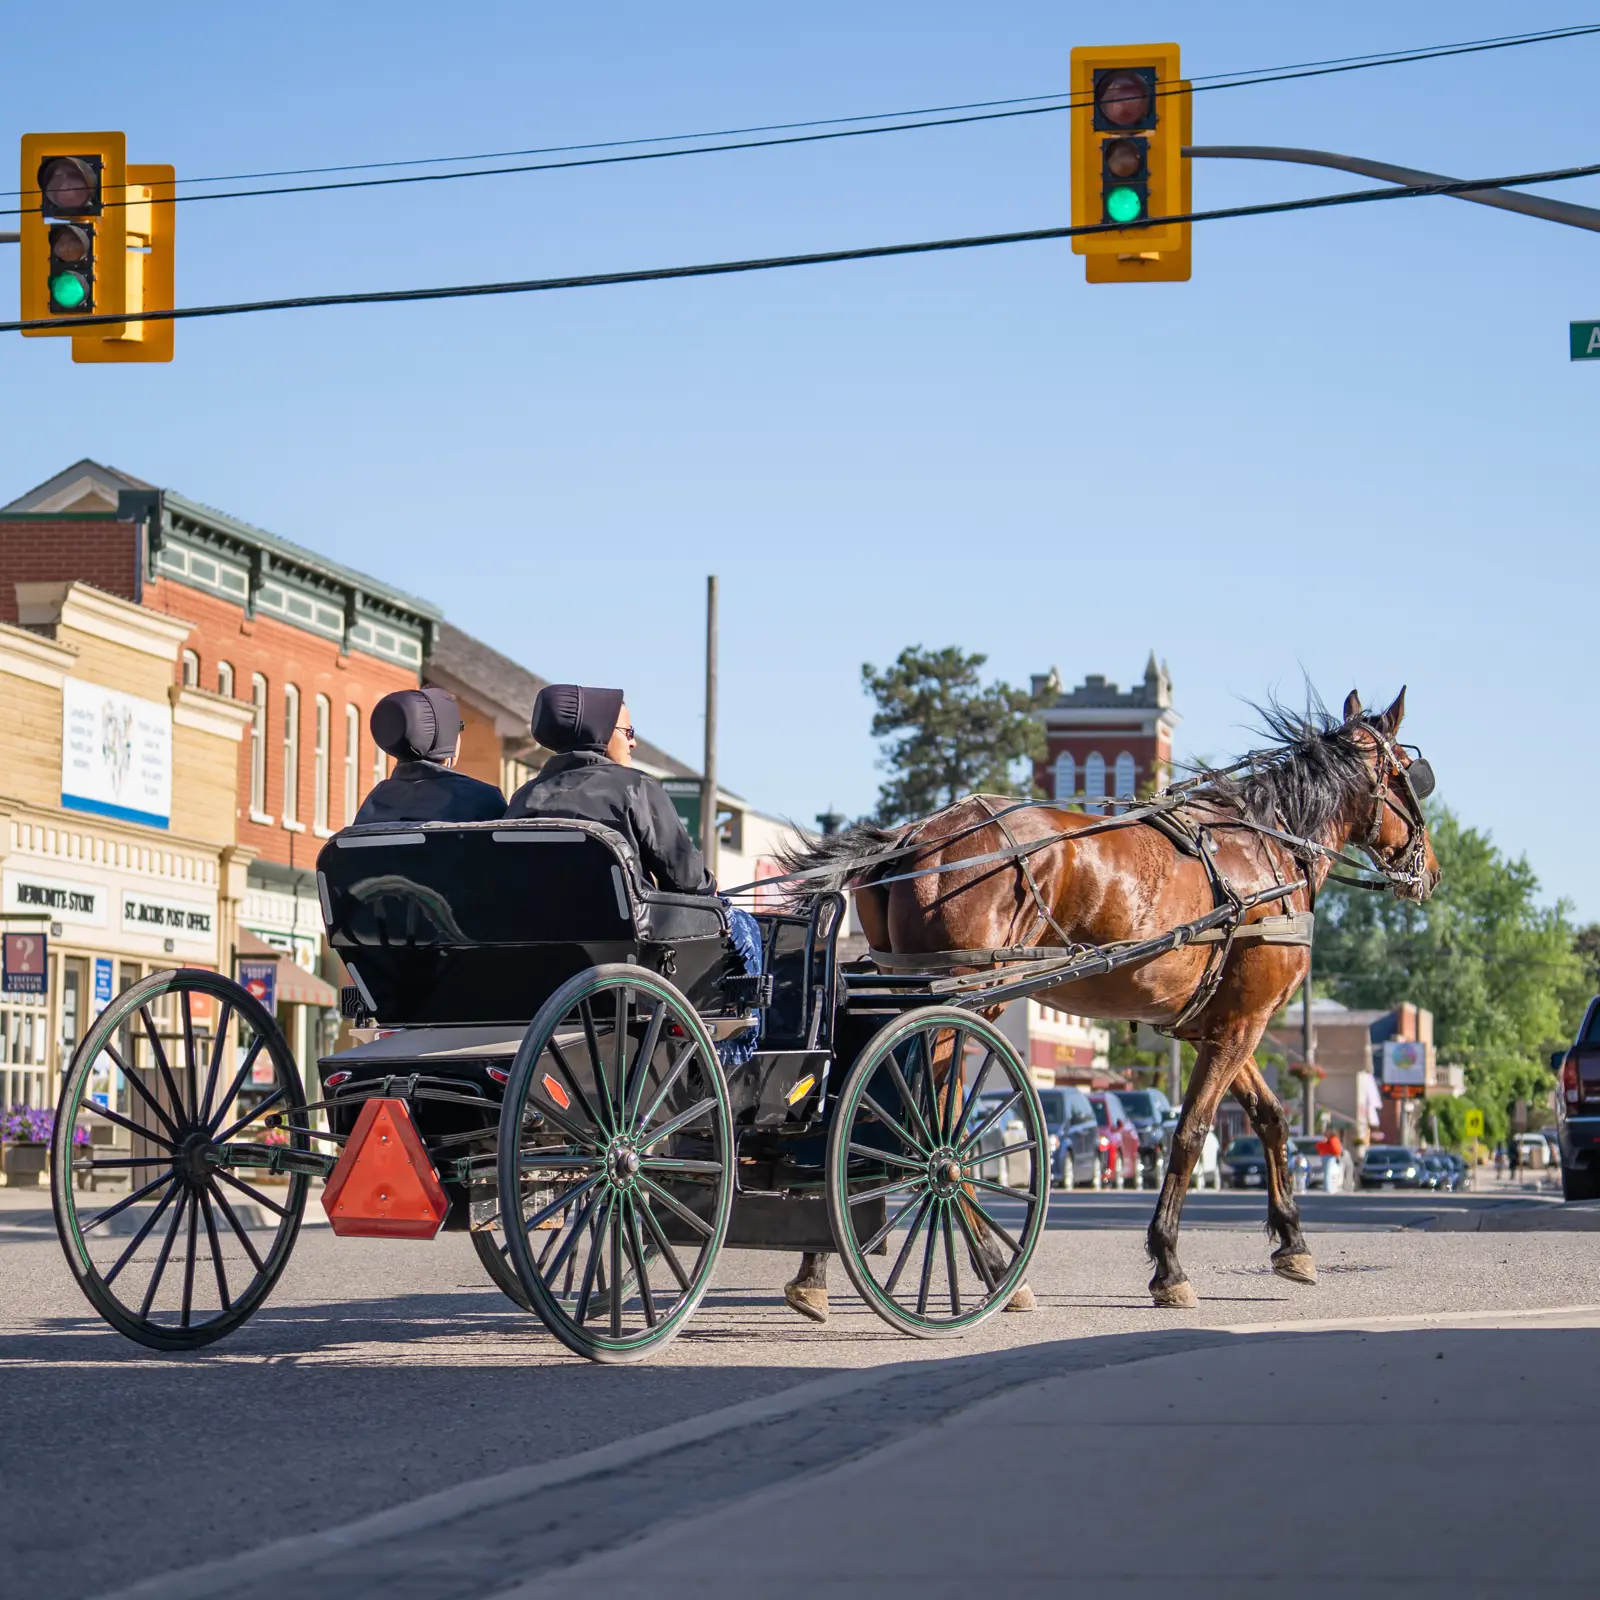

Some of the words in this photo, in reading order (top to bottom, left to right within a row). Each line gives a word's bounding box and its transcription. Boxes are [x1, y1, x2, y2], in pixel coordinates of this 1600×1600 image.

[69, 890, 95, 914] STORY
[166, 908, 185, 928] POST
[187, 911, 211, 932] OFFICE
[7, 983, 43, 991] CENTRE
[8, 975, 43, 984] VISITOR
